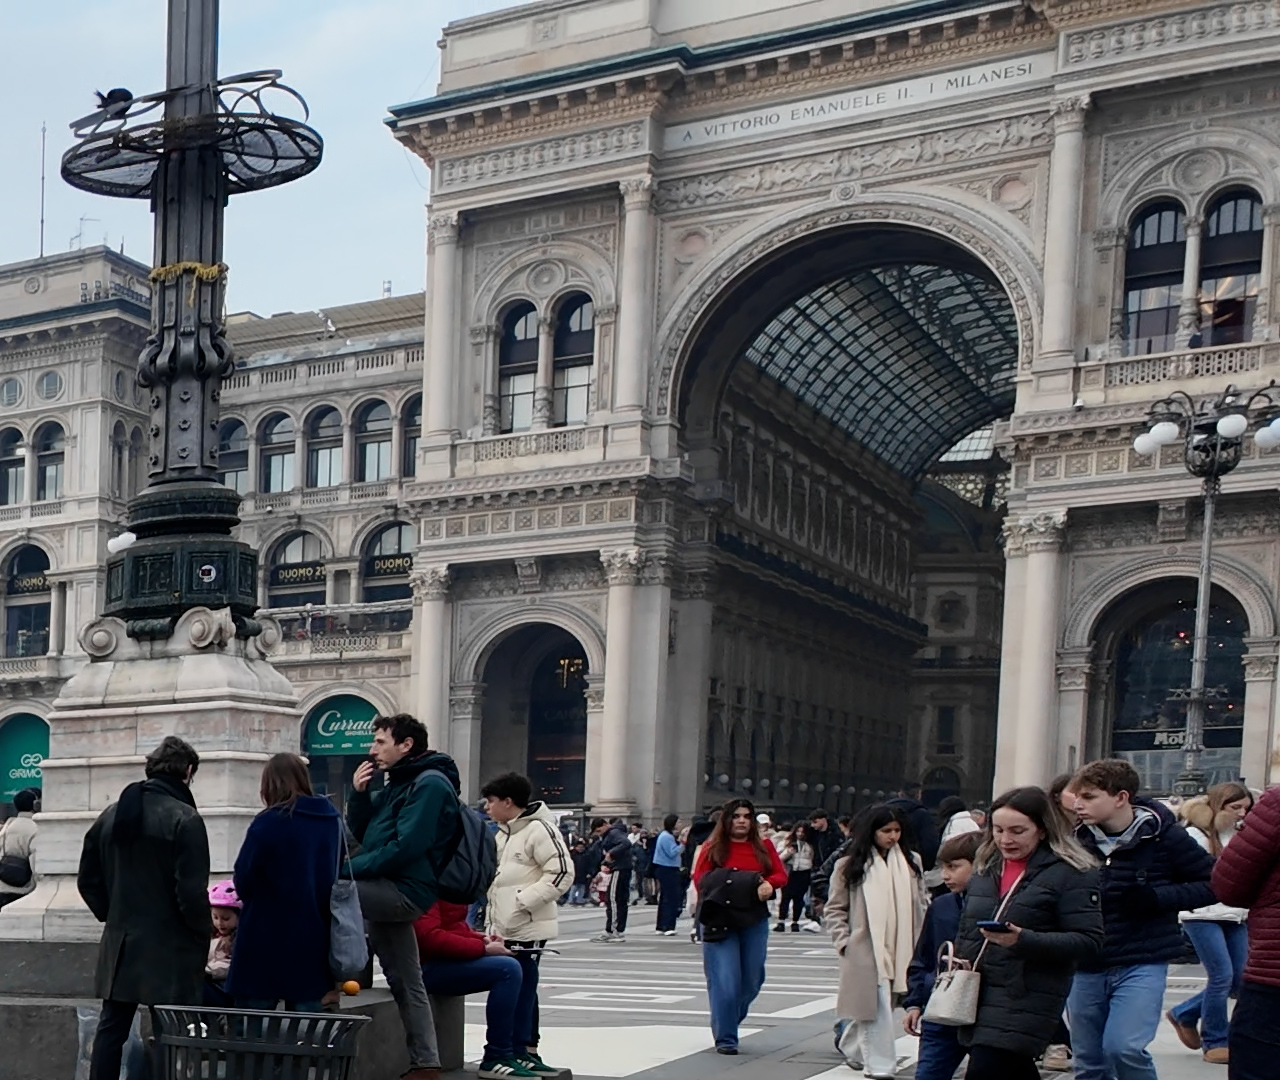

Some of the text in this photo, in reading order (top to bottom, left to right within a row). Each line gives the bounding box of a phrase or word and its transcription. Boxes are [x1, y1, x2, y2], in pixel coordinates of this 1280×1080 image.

[683, 130, 692, 141] A
[704, 113, 780, 136] VITTORIO
[790, 92, 886, 121] EMANUELE
[929, 82, 934, 94] I
[945, 62, 1033, 91] MILANESI
[374, 558, 411, 570] DUOMO
[278, 568, 313, 579] DUOMO
[14, 577, 44, 588] DUOMO
[317, 710, 378, 737] Currad
[1153, 731, 1186, 745] Mot
[8, 768, 43, 779] GRIMO
